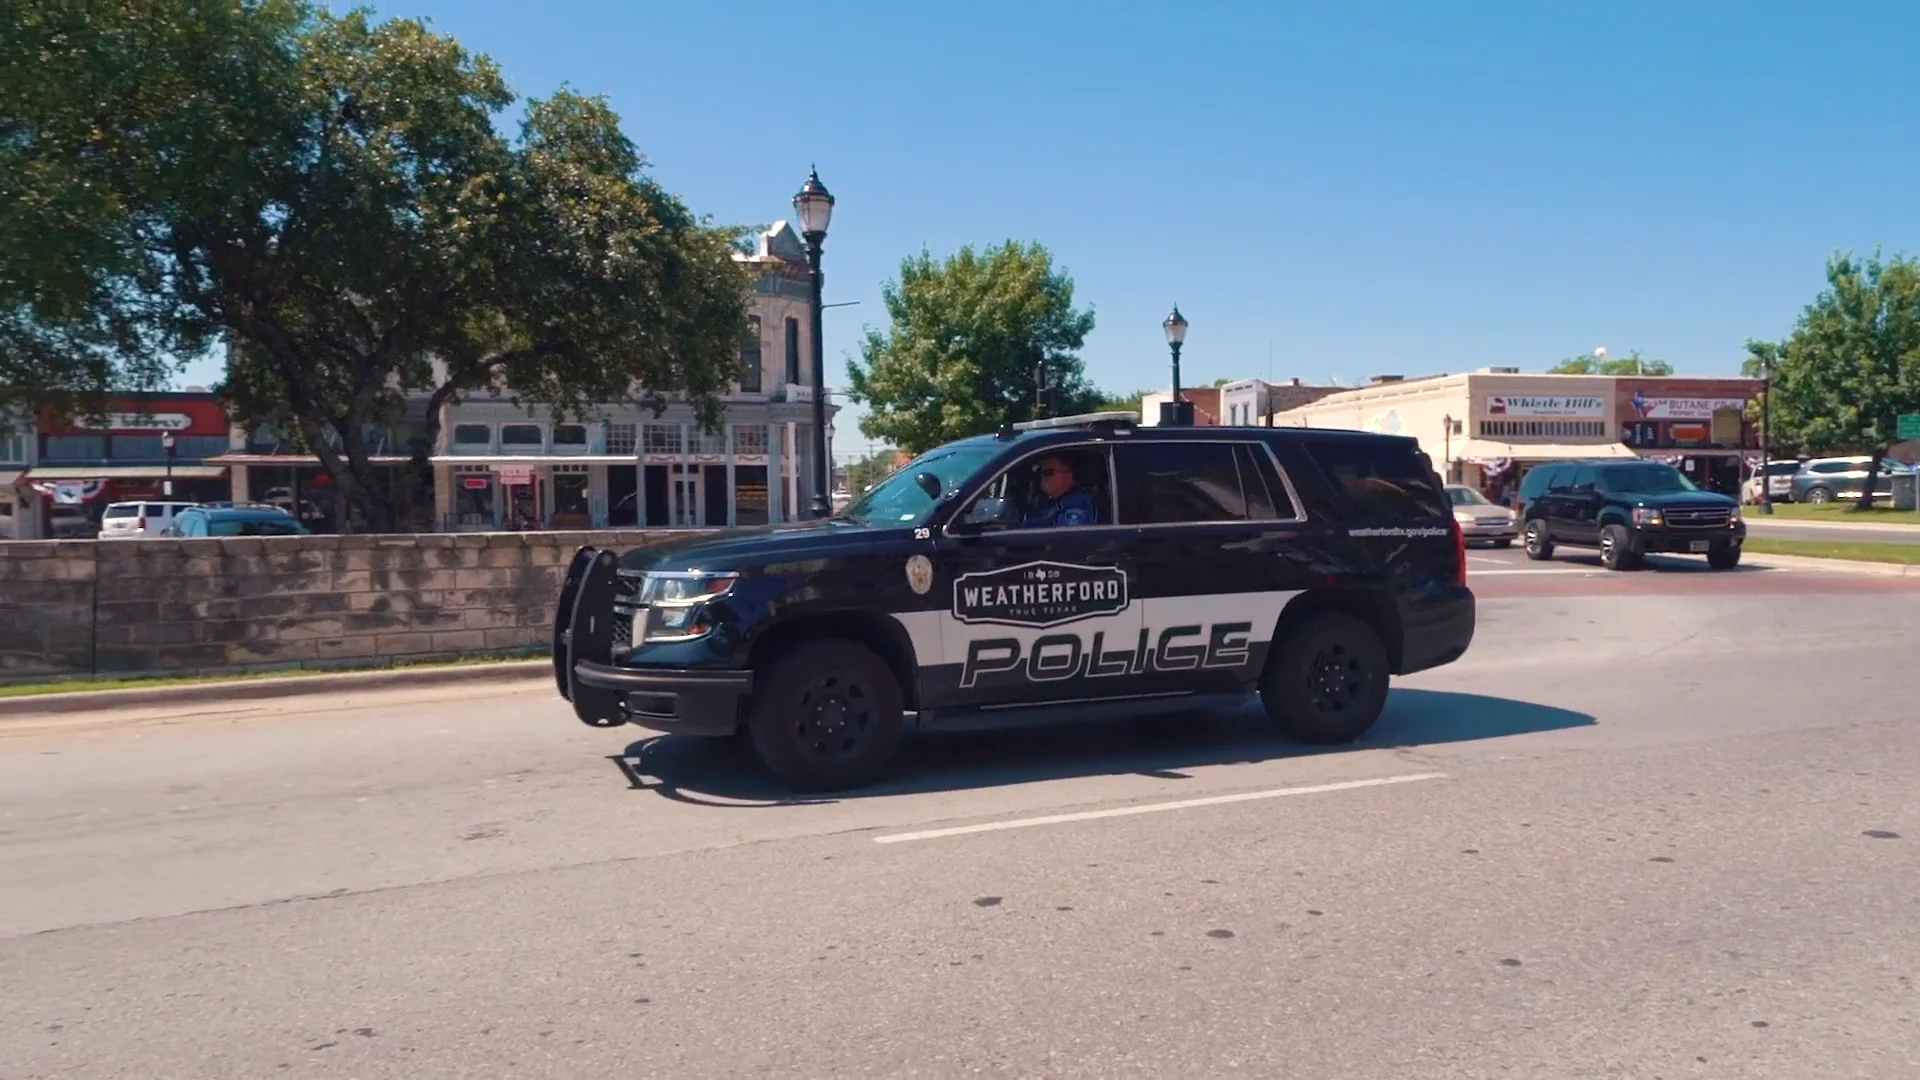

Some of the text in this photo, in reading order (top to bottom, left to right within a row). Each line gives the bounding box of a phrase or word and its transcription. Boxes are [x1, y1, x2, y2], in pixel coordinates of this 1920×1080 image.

[1507, 397, 1602, 408] Whistle Hill's
[1669, 400, 1709, 409] BUTANE
[914, 527, 930, 539] 29
[964, 580, 1118, 607] WEATHERFORD
[1009, 605, 1077, 616] TRUE TEXAS
[959, 621, 1252, 688] POLICE
